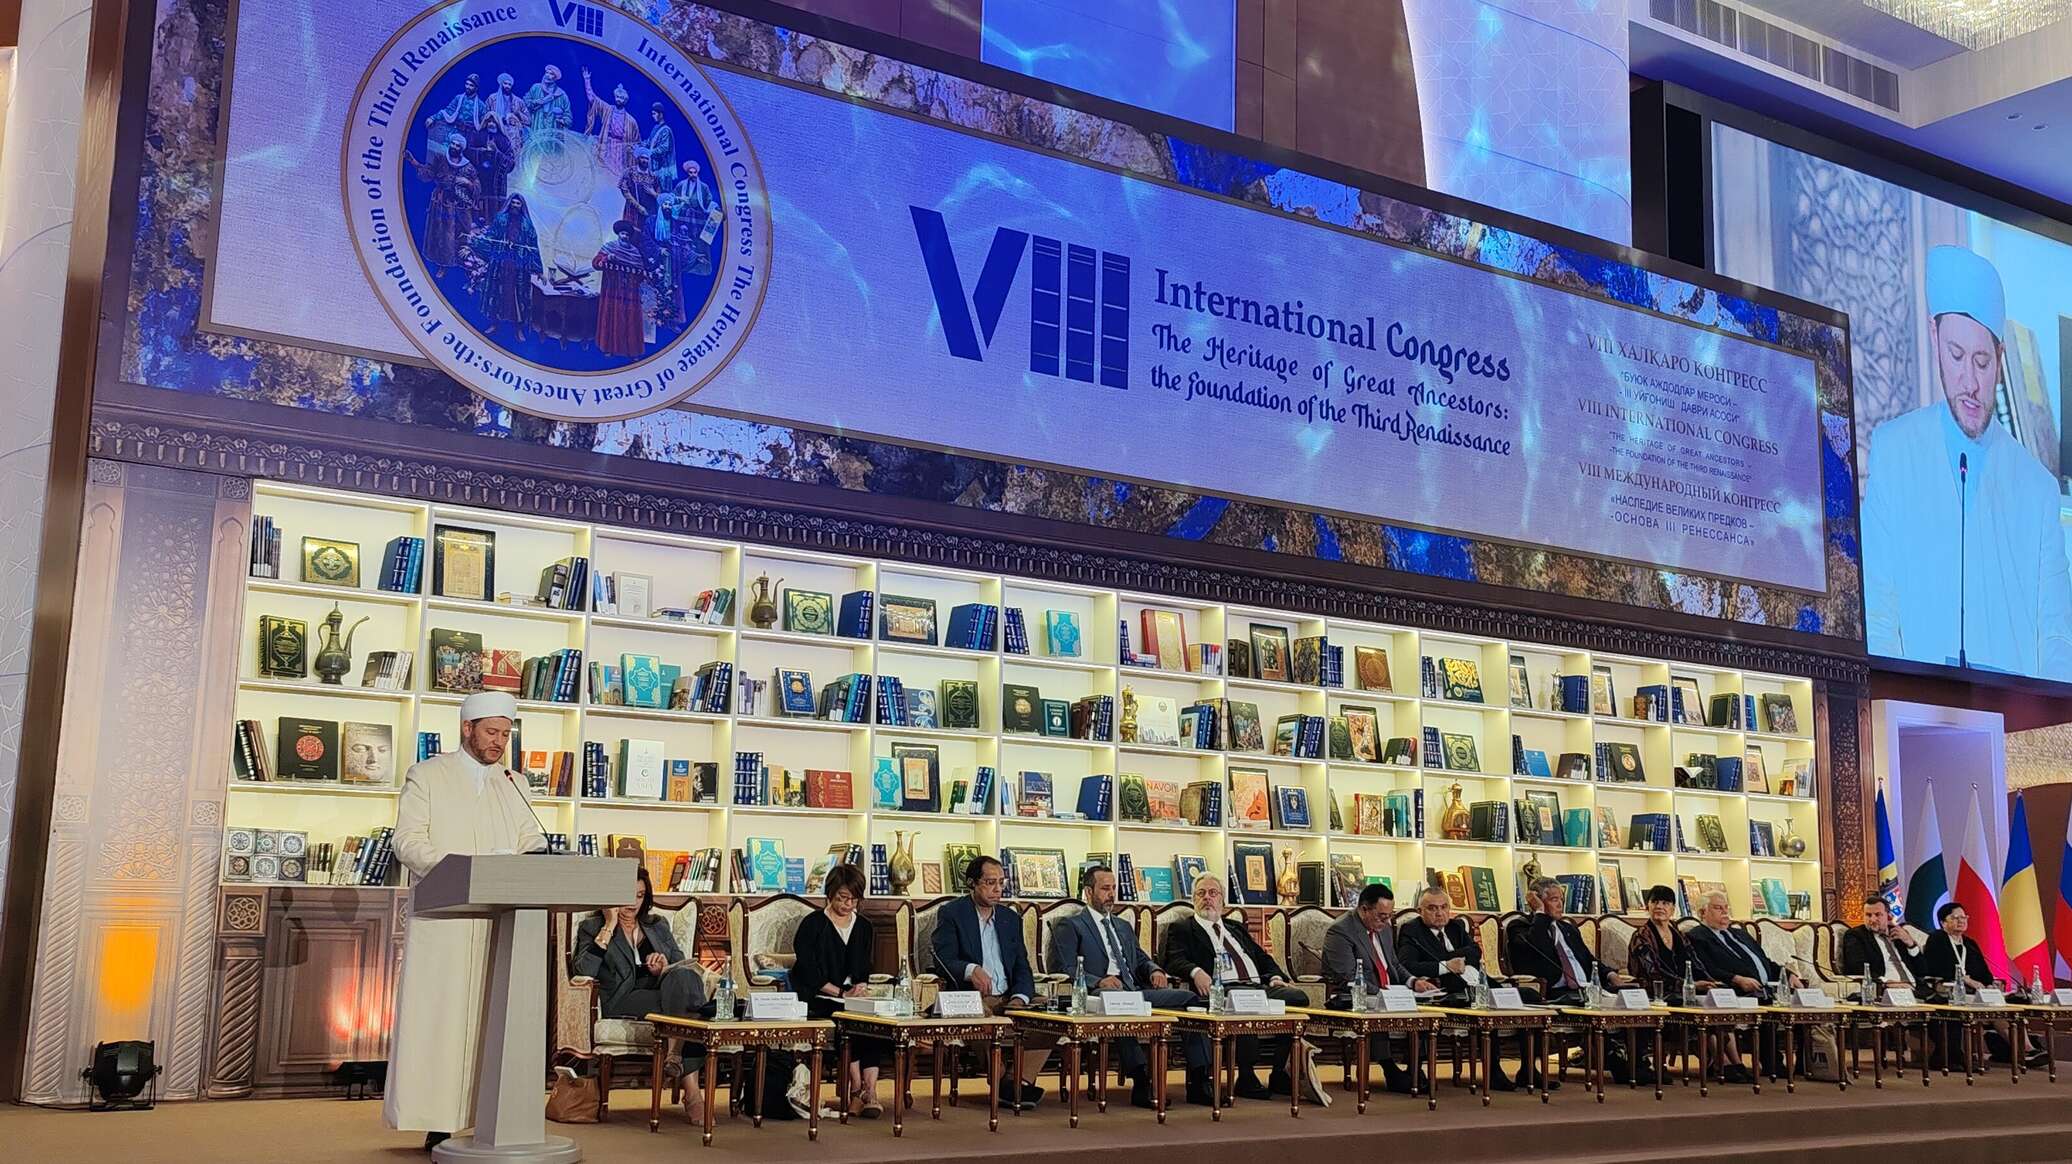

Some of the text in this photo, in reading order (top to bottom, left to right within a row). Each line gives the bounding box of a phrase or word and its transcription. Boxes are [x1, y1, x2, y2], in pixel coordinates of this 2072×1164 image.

[401, 6, 518, 72] Renaissance
[549, 0, 604, 37] VIII
[368, 68, 409, 128] Third
[637, 38, 739, 156] International
[362, 136, 384, 170] the
[361, 174, 382, 199] of
[730, 162, 753, 257] Congress
[370, 208, 443, 335] Foundation
[731, 265, 754, 300] The
[909, 205, 1130, 390] VIII
[680, 303, 741, 372] Heritage
[1155, 268, 1511, 384] International Congress
[594, 379, 653, 404] Great
[655, 368, 675, 391] of
[1152, 323, 1508, 420] The Heritage of Great Ancestors:
[1586, 333, 1614, 354] VIII
[1693, 360, 1768, 393] КОНГРЕСС
[1151, 365, 1182, 391] the
[1298, 394, 1318, 424] of
[1319, 398, 1346, 423] the
[1351, 403, 1400, 434] Third
[1399, 410, 1511, 455] Renaissance
[1578, 399, 1778, 456] VIII INTERNATIONAL CONGRESS
[1681, 401, 1708, 416] ДАВРИ
[1667, 444, 1676, 452] OF
[1680, 446, 1702, 457] GREAT
[1706, 453, 1744, 468] ANCESTORS
[1667, 458, 1675, 466] OF
[1677, 460, 1688, 470] THE
[1690, 462, 1708, 473] THIRD
[1578, 461, 1781, 513] VIII МЕЖДУНАРОДНЫЙ КОНГРЕСС
[1666, 504, 1706, 521] ВЕЛИКИХ
